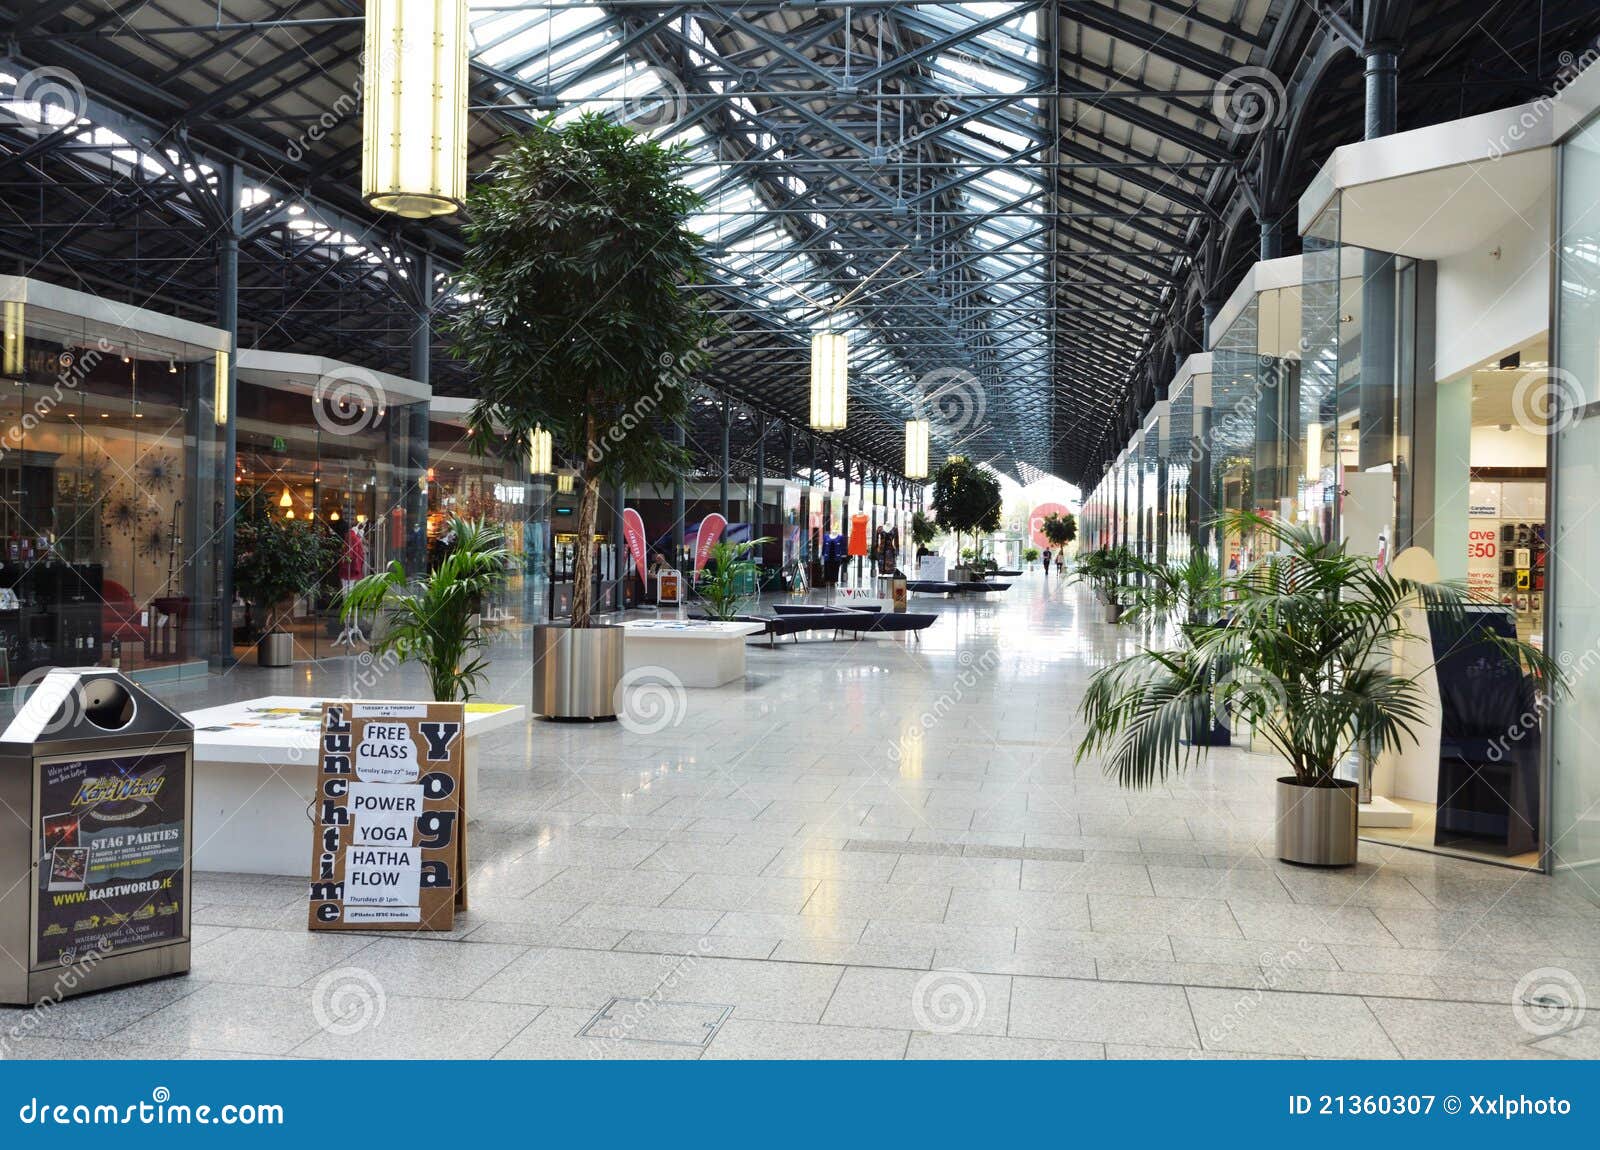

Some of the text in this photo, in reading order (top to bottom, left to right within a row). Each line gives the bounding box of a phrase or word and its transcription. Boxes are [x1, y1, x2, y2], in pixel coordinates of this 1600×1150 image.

[1469, 531, 1495, 540] ave
[368, 725, 406, 741] FREE
[360, 743, 408, 759] CLASS
[358, 767, 380, 775] Tuesday
[381, 768, 393, 776] 1pm
[405, 769, 418, 777] Sept
[354, 796, 416, 811] POWER
[91, 828, 179, 850] STAG PARTIES
[361, 826, 408, 841] YOGA
[352, 851, 410, 866] HATHA
[352, 871, 401, 886] FLOW
